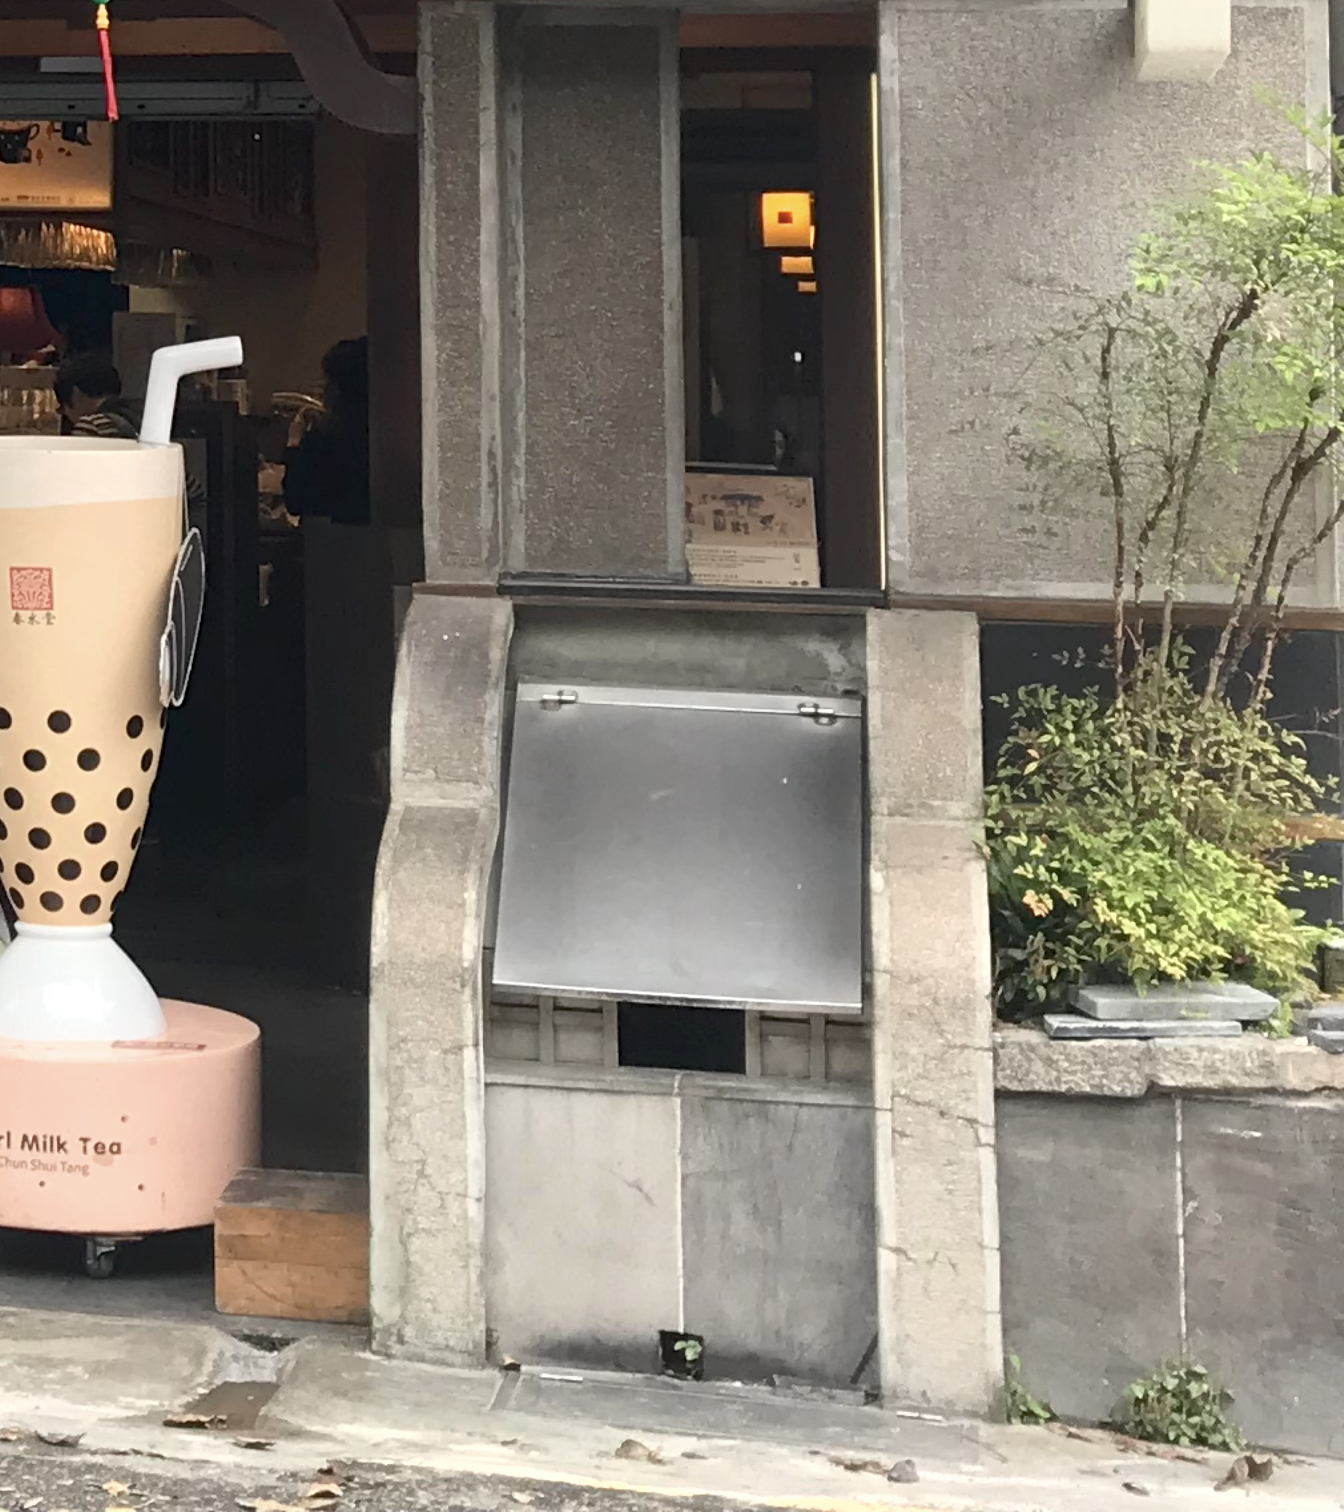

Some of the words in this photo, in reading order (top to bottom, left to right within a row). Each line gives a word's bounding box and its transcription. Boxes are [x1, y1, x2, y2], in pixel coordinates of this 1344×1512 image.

[20, 1133, 69, 1155] Milk
[78, 1136, 123, 1155] Tea
[30, 1158, 57, 1173] Shui
[61, 1160, 90, 1178] Tang
